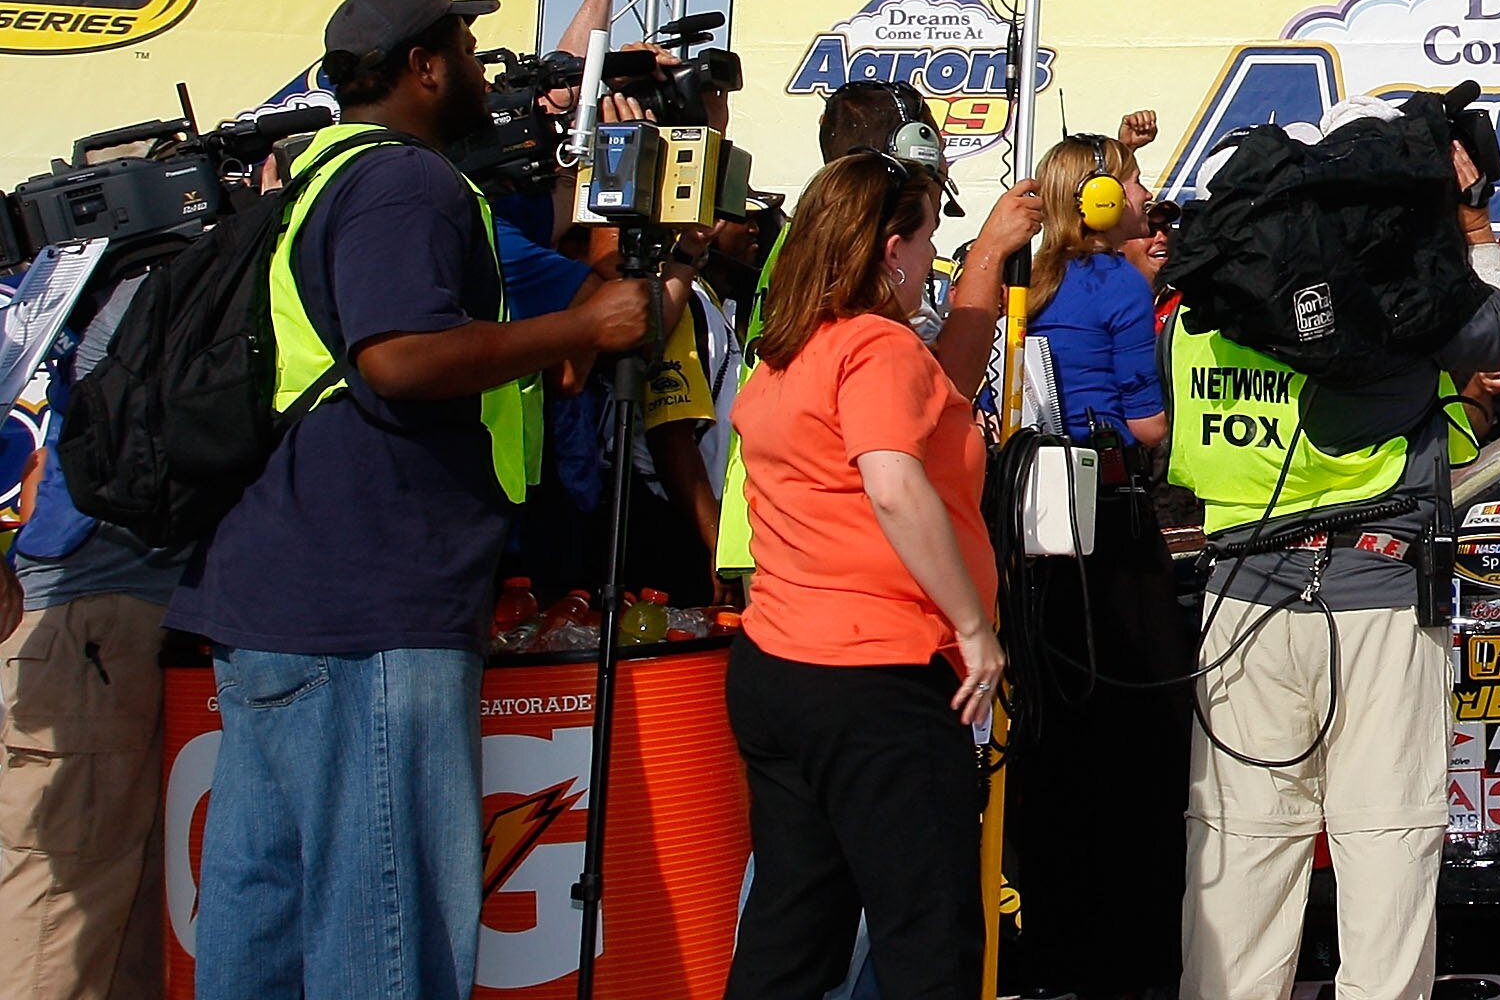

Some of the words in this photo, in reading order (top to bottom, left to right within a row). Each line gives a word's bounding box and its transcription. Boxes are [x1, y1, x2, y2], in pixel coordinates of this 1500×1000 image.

[888, 9, 972, 26] Dreams
[874, 26, 922, 41] Come
[922, 26, 962, 40] True
[963, 25, 984, 40] At
[1297, 295, 1330, 316] porta
[1300, 310, 1334, 329] brace
[1190, 366, 1298, 405] NETWORK
[1201, 413, 1287, 450] FOX
[480, 693, 593, 716] GATORADE
